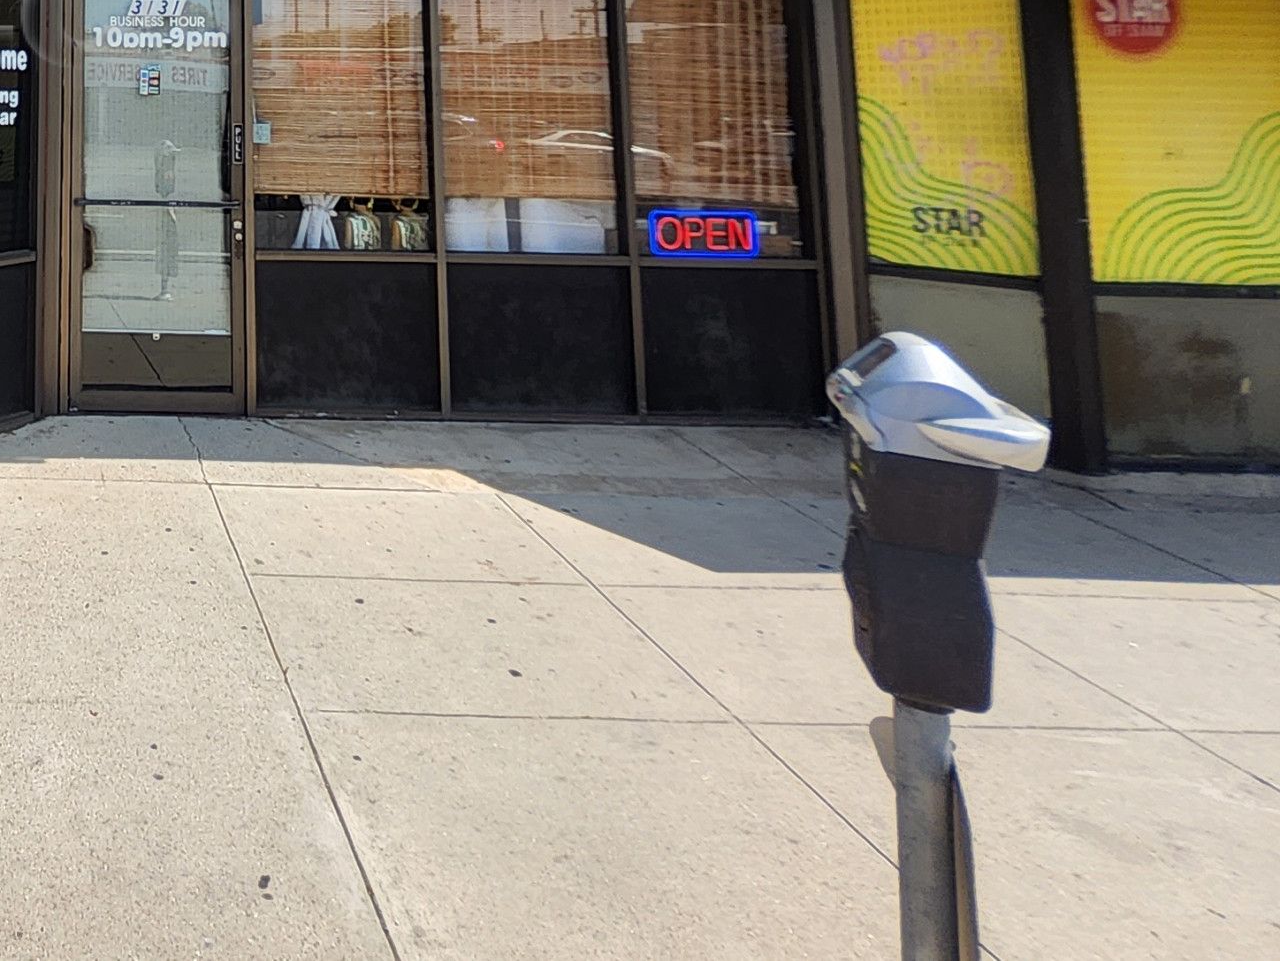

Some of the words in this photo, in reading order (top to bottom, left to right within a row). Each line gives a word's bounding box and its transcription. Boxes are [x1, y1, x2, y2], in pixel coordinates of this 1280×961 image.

[110, 16, 164, 27] BUSINESS
[170, 16, 206, 28] HOUR
[657, 216, 753, 250] OPEN
[911, 206, 987, 237] STAR
